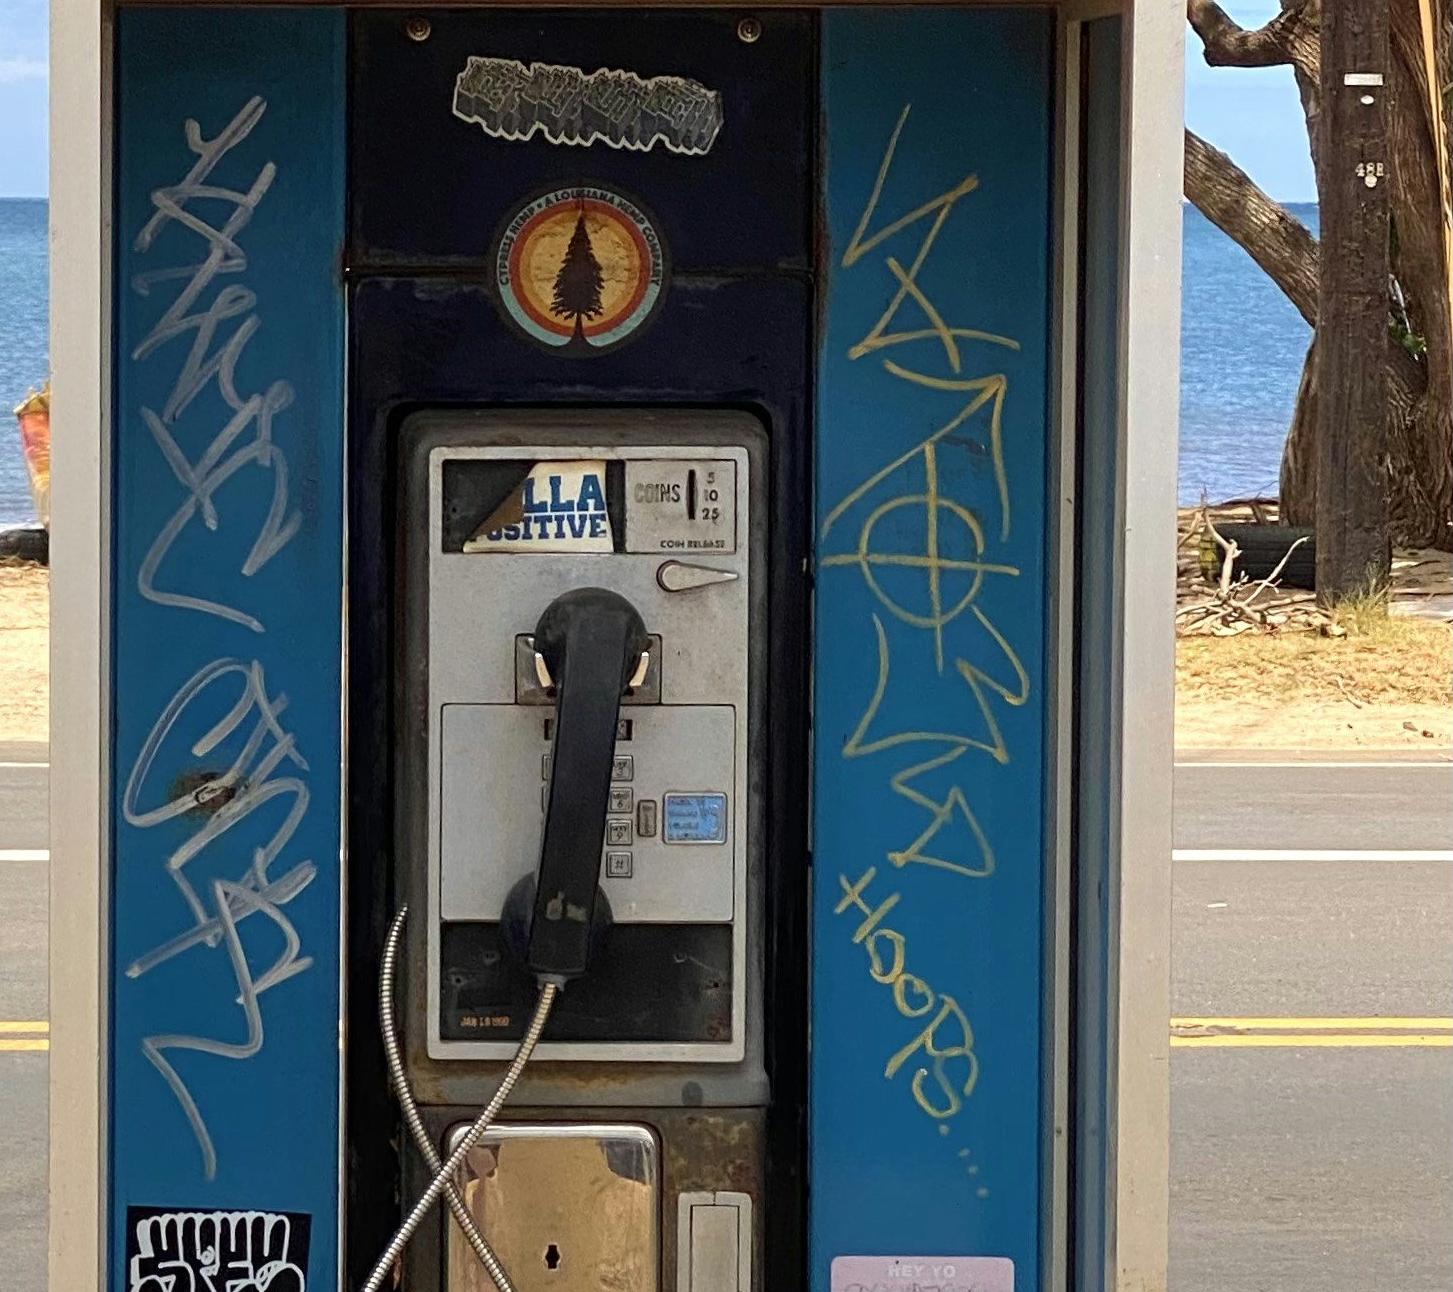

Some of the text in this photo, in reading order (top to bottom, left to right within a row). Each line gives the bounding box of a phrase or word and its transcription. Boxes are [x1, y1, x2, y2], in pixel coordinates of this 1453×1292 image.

[706, 471, 716, 485] 5
[634, 483, 681, 504] COINS
[703, 488, 719, 502] 10
[702, 507, 720, 521] 25
[659, 539, 686, 549] COIN
[887, 1264, 957, 1279] HEY YO
